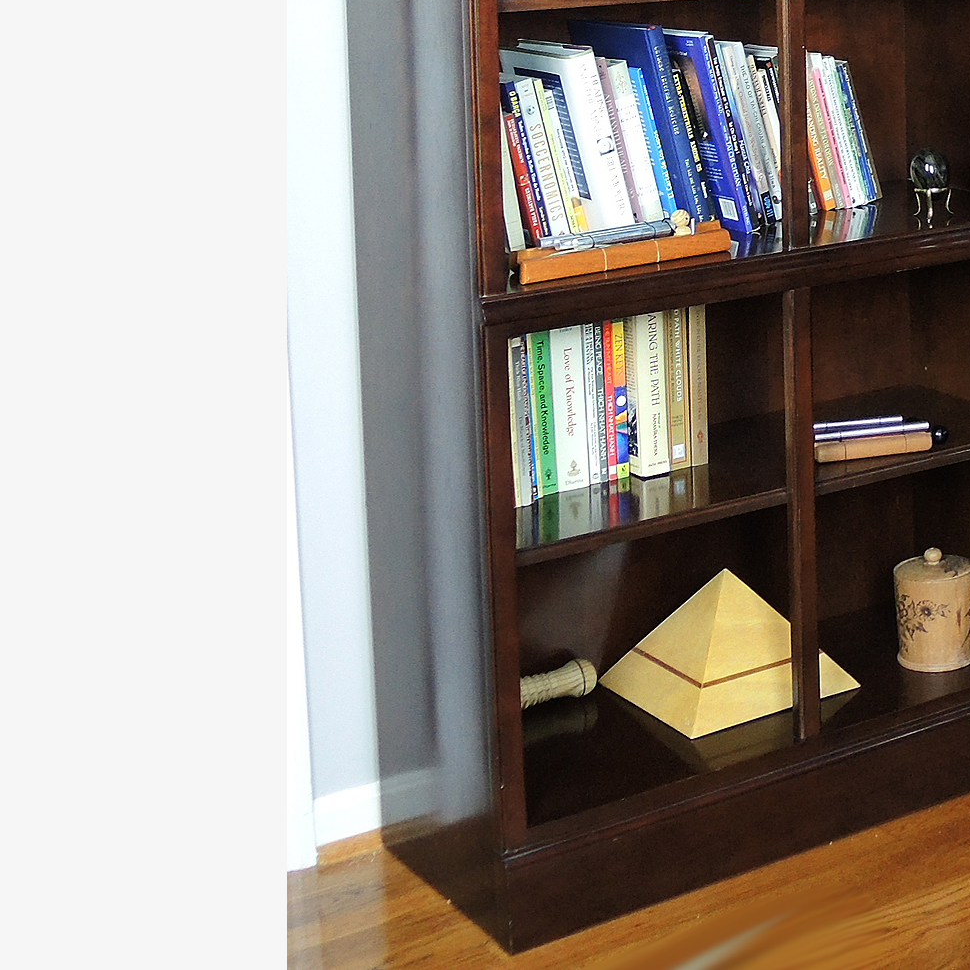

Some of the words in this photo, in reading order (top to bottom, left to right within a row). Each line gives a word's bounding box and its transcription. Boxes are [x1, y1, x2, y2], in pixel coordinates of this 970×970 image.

[529, 123, 565, 222] SOCCERNOMICS
[813, 148, 827, 180] REALITY
[674, 317, 682, 339] PATH
[536, 340, 545, 364] Time,
[615, 334, 623, 352] ZEN
[563, 348, 573, 371] Love
[615, 354, 624, 376] KEYS
[648, 353, 658, 377] THE
[536, 364, 547, 392] Space,
[565, 374, 573, 384] of
[540, 394, 548, 409] and
[649, 379, 660, 406] PATH
[565, 386, 577, 437] Knowledge
[541, 410, 551, 455] Knowledge
